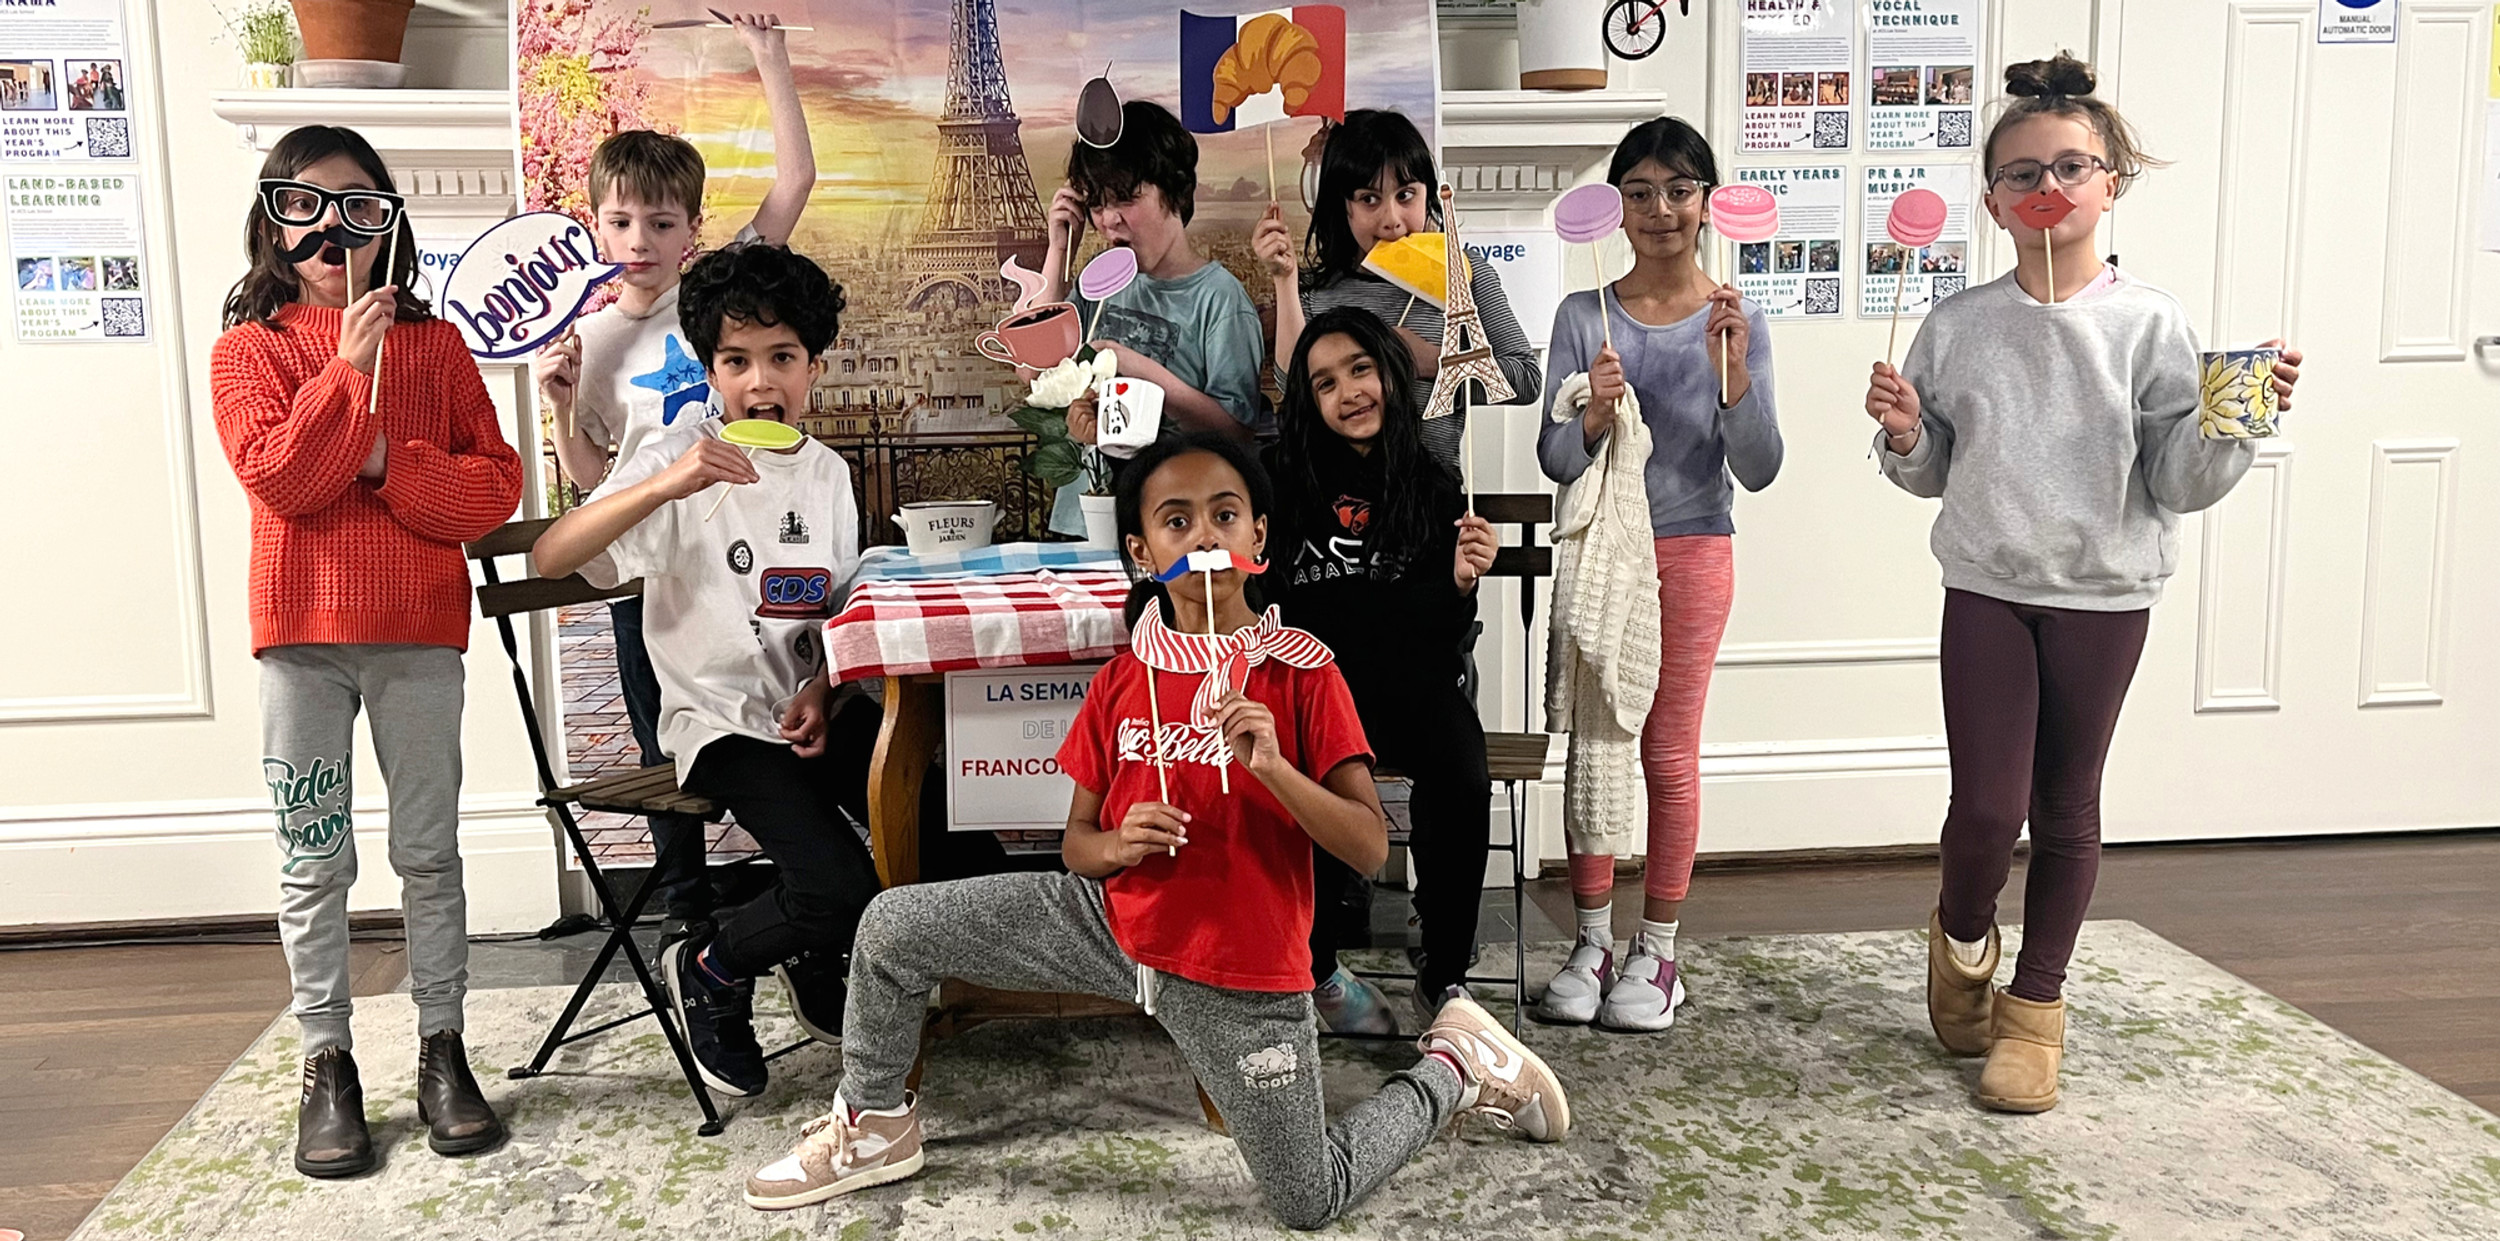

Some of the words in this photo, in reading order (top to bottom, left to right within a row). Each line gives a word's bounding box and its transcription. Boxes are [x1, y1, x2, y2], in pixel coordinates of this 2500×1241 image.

[1873, 1, 1922, 11] VOCAL
[1873, 14, 1960, 26] TECHNIQUE
[2339, 15, 2371, 23] MANUAL
[2323, 26, 2367, 34] AUTOMATIC
[2369, 25, 2392, 33] DOOR
[1745, 112, 1776, 120] LEARN
[1780, 111, 1806, 119] MORE
[1871, 111, 1901, 119] LEARN
[2, 117, 39, 125] LEARN
[43, 117, 75, 125] MORE
[1870, 121, 1901, 129] ABOUT
[4, 128, 40, 136] ABOUT
[46, 128, 71, 136] THIS
[5, 138, 44, 146] YEAR'S
[1745, 141, 1790, 149] PROGRAM
[5, 149, 60, 157] PROGRAM
[1740, 169, 1786, 181] EARLY
[1793, 168, 1840, 180] YEARS
[1868, 168, 1887, 179] PR
[1893, 168, 1902, 178] &
[1908, 168, 1926, 178] JR
[9, 178, 124, 190] LAND-BASED
[10, 194, 102, 206] LEARNING
[417, 249, 460, 270] oya
[1738, 280, 1768, 288] LEARN
[1865, 277, 1895, 285] LEARN
[447, 226, 590, 352] bonjour
[1773, 288, 1794, 296] THIS
[19, 298, 55, 306] LEARN
[20, 308, 56, 316] ABOUT
[62, 308, 87, 316] THIS
[22, 329, 77, 337] PROGRAM
[928, 517, 975, 531] FLEURS
[939, 534, 966, 543] JARDIN
[765, 575, 828, 604] CDS
[986, 684, 1014, 702] LA
[1022, 720, 1055, 739] DE
[962, 757, 1067, 776] FRANCO
